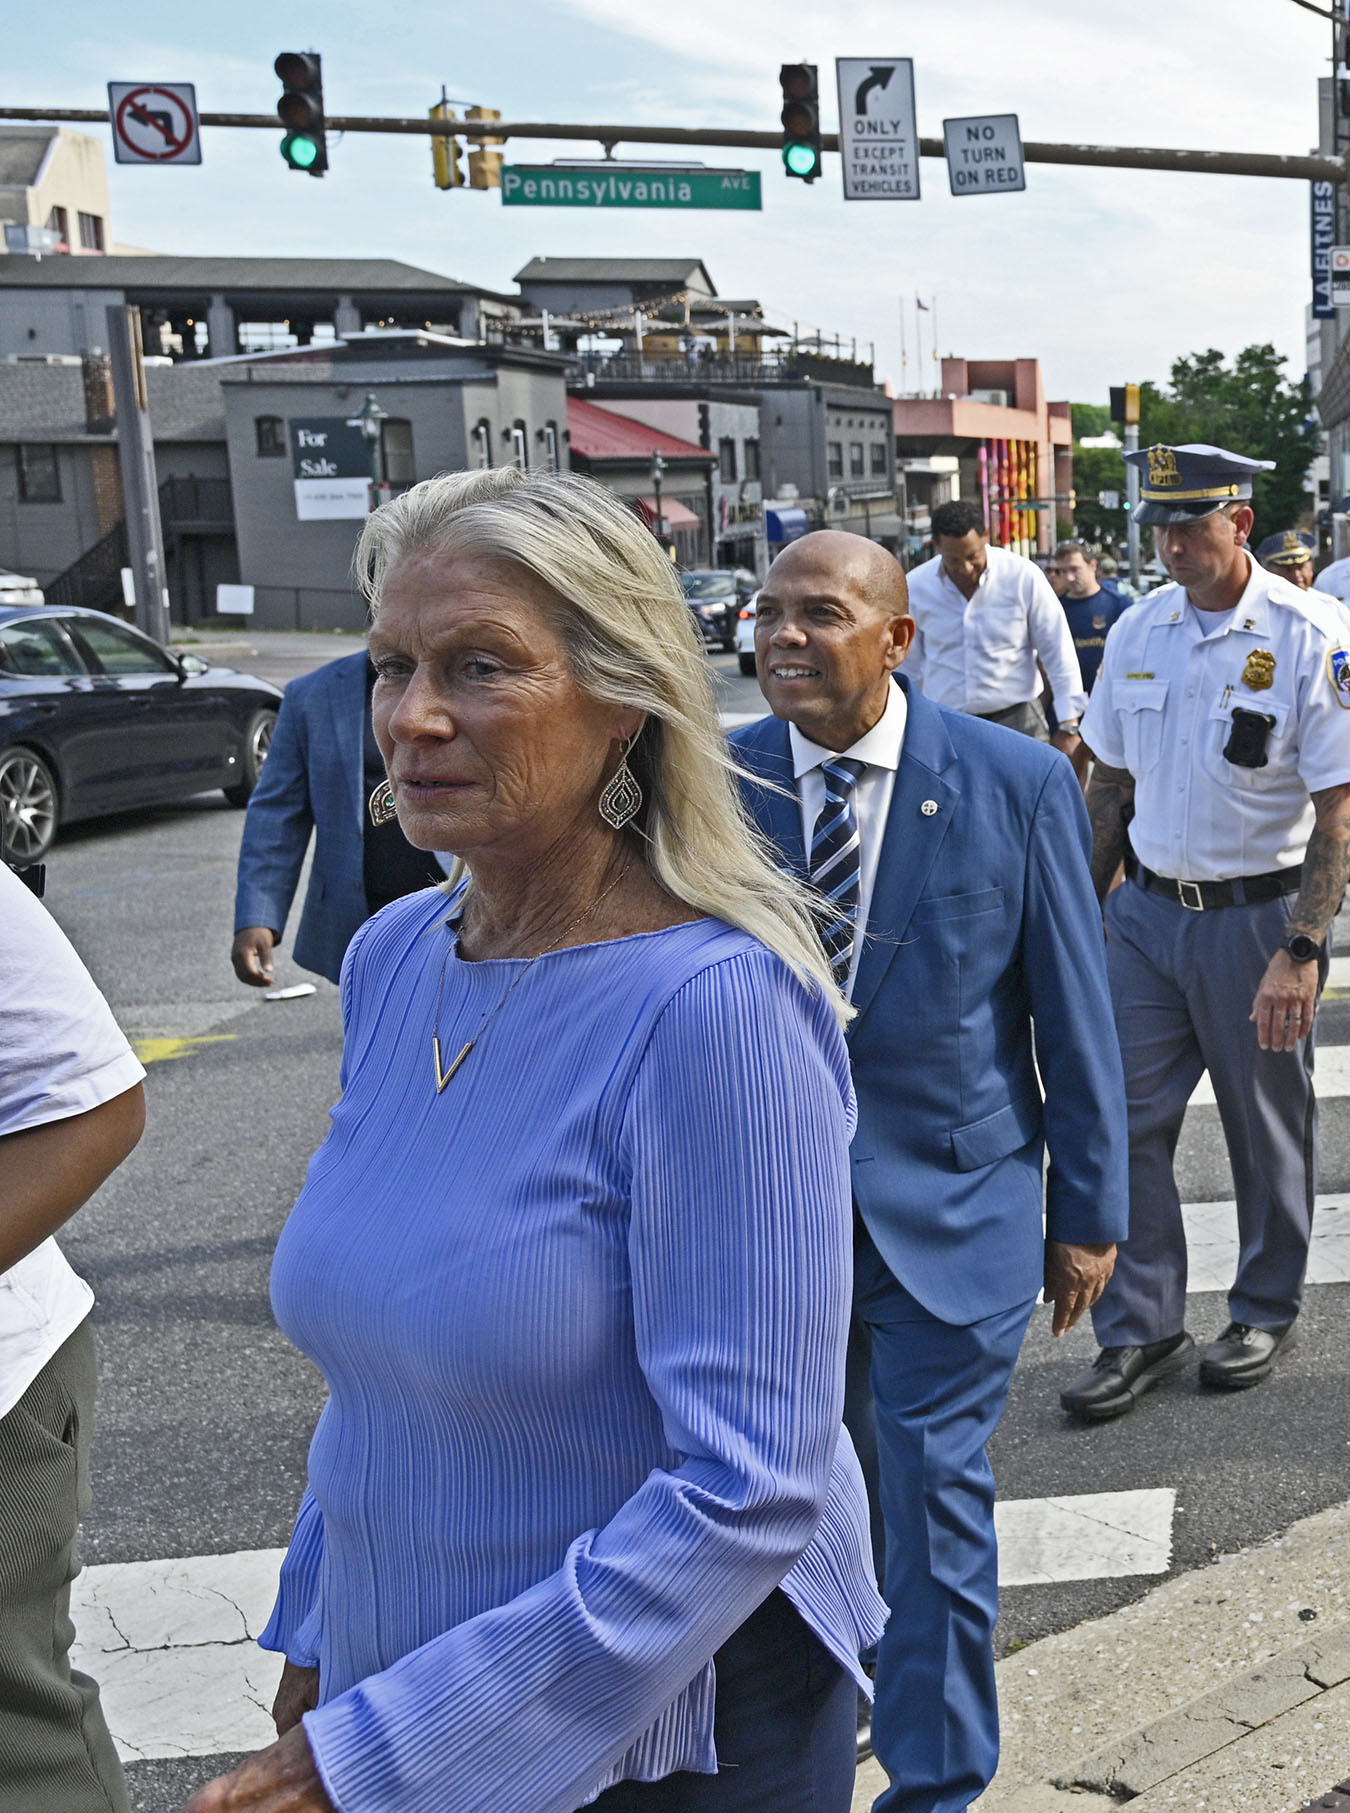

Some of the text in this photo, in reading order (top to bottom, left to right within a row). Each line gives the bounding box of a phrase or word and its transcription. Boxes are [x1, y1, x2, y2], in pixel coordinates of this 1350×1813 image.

[854, 120, 901, 135] ONLY
[966, 126, 995, 142] NO
[853, 147, 905, 160] EXCEPT
[962, 147, 1007, 164] TURN
[852, 163, 909, 176] TRANSIT
[956, 167, 1019, 186] ON RED
[503, 173, 751, 205] Pennsylvania AVE
[852, 179, 912, 194] VEHICLES
[1314, 181, 1335, 312] LA FITNES
[298, 429, 328, 448] For
[300, 457, 338, 476] Sale
